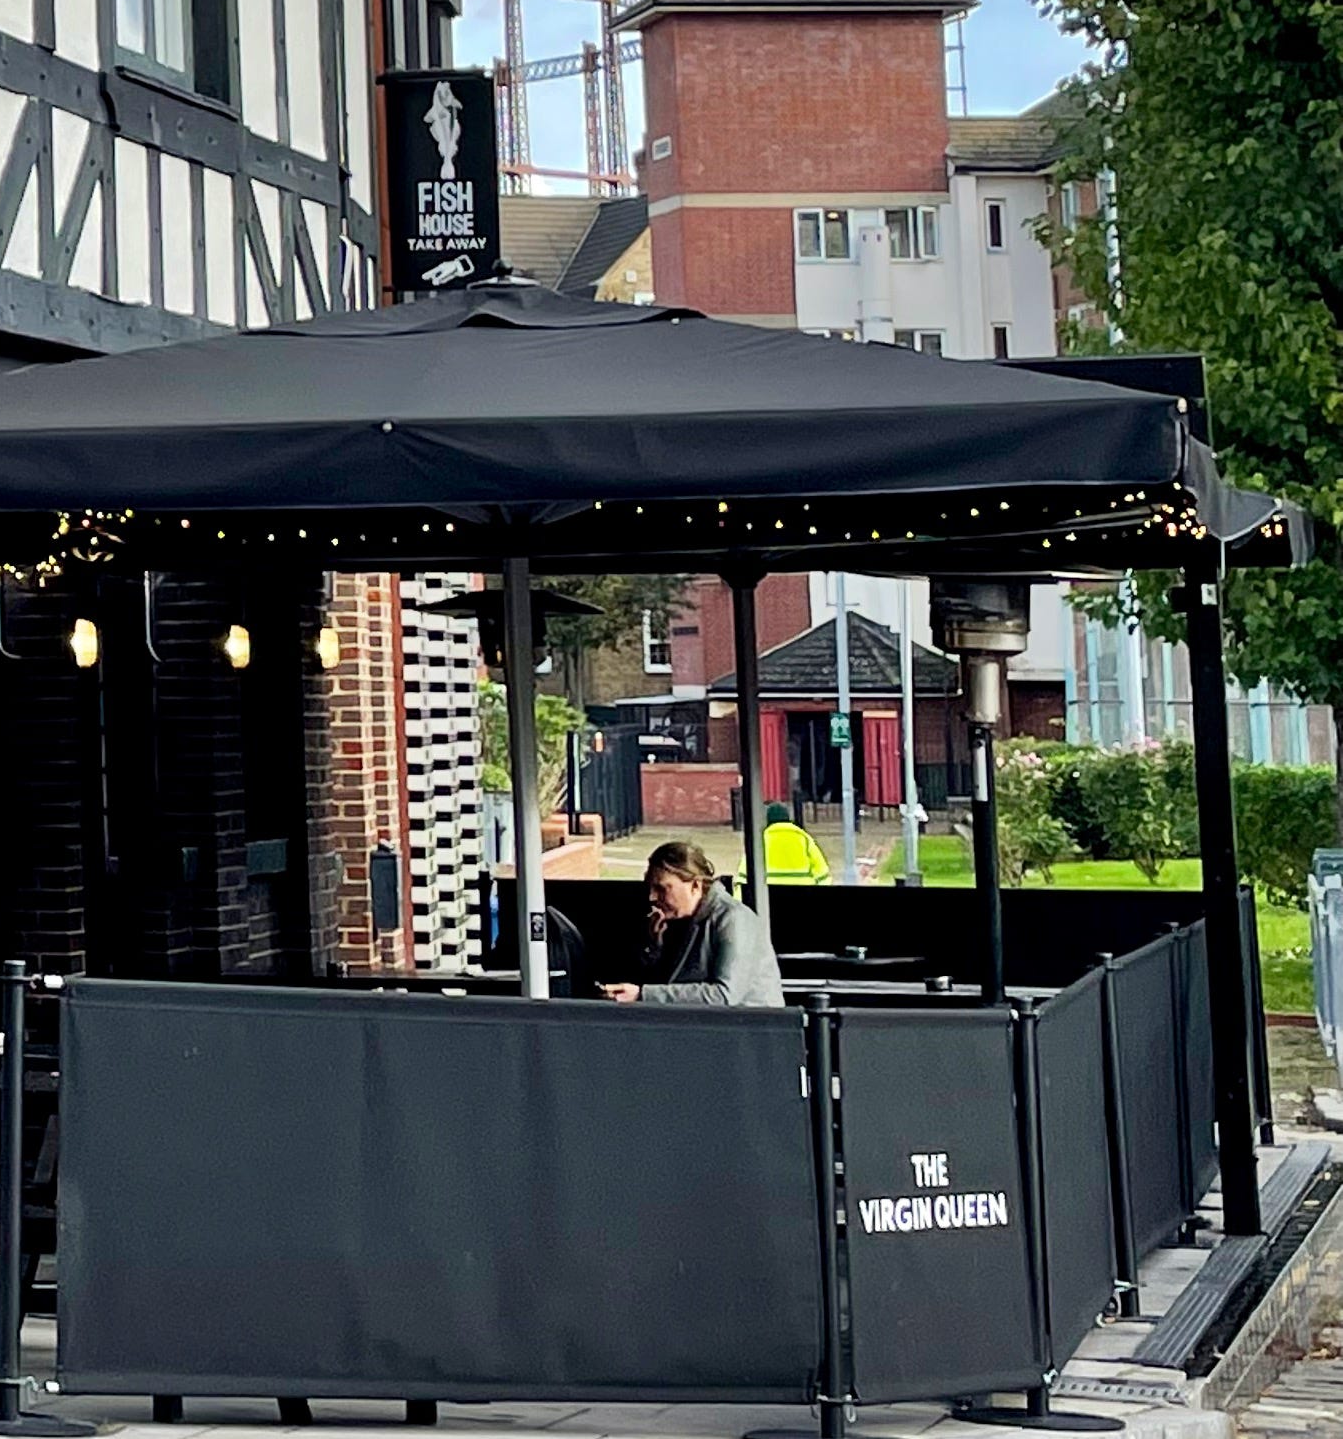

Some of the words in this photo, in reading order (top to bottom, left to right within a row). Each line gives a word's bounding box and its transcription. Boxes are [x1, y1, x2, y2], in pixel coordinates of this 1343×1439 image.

[417, 180, 474, 213] FISH
[418, 213, 475, 237] HOUSE
[407, 237, 443, 251] TAKE
[445, 236, 488, 250] AWAY
[910, 1153, 950, 1188] THE
[858, 1196, 934, 1234] VIRGIN
[934, 1191, 1008, 1230] QUEEN
